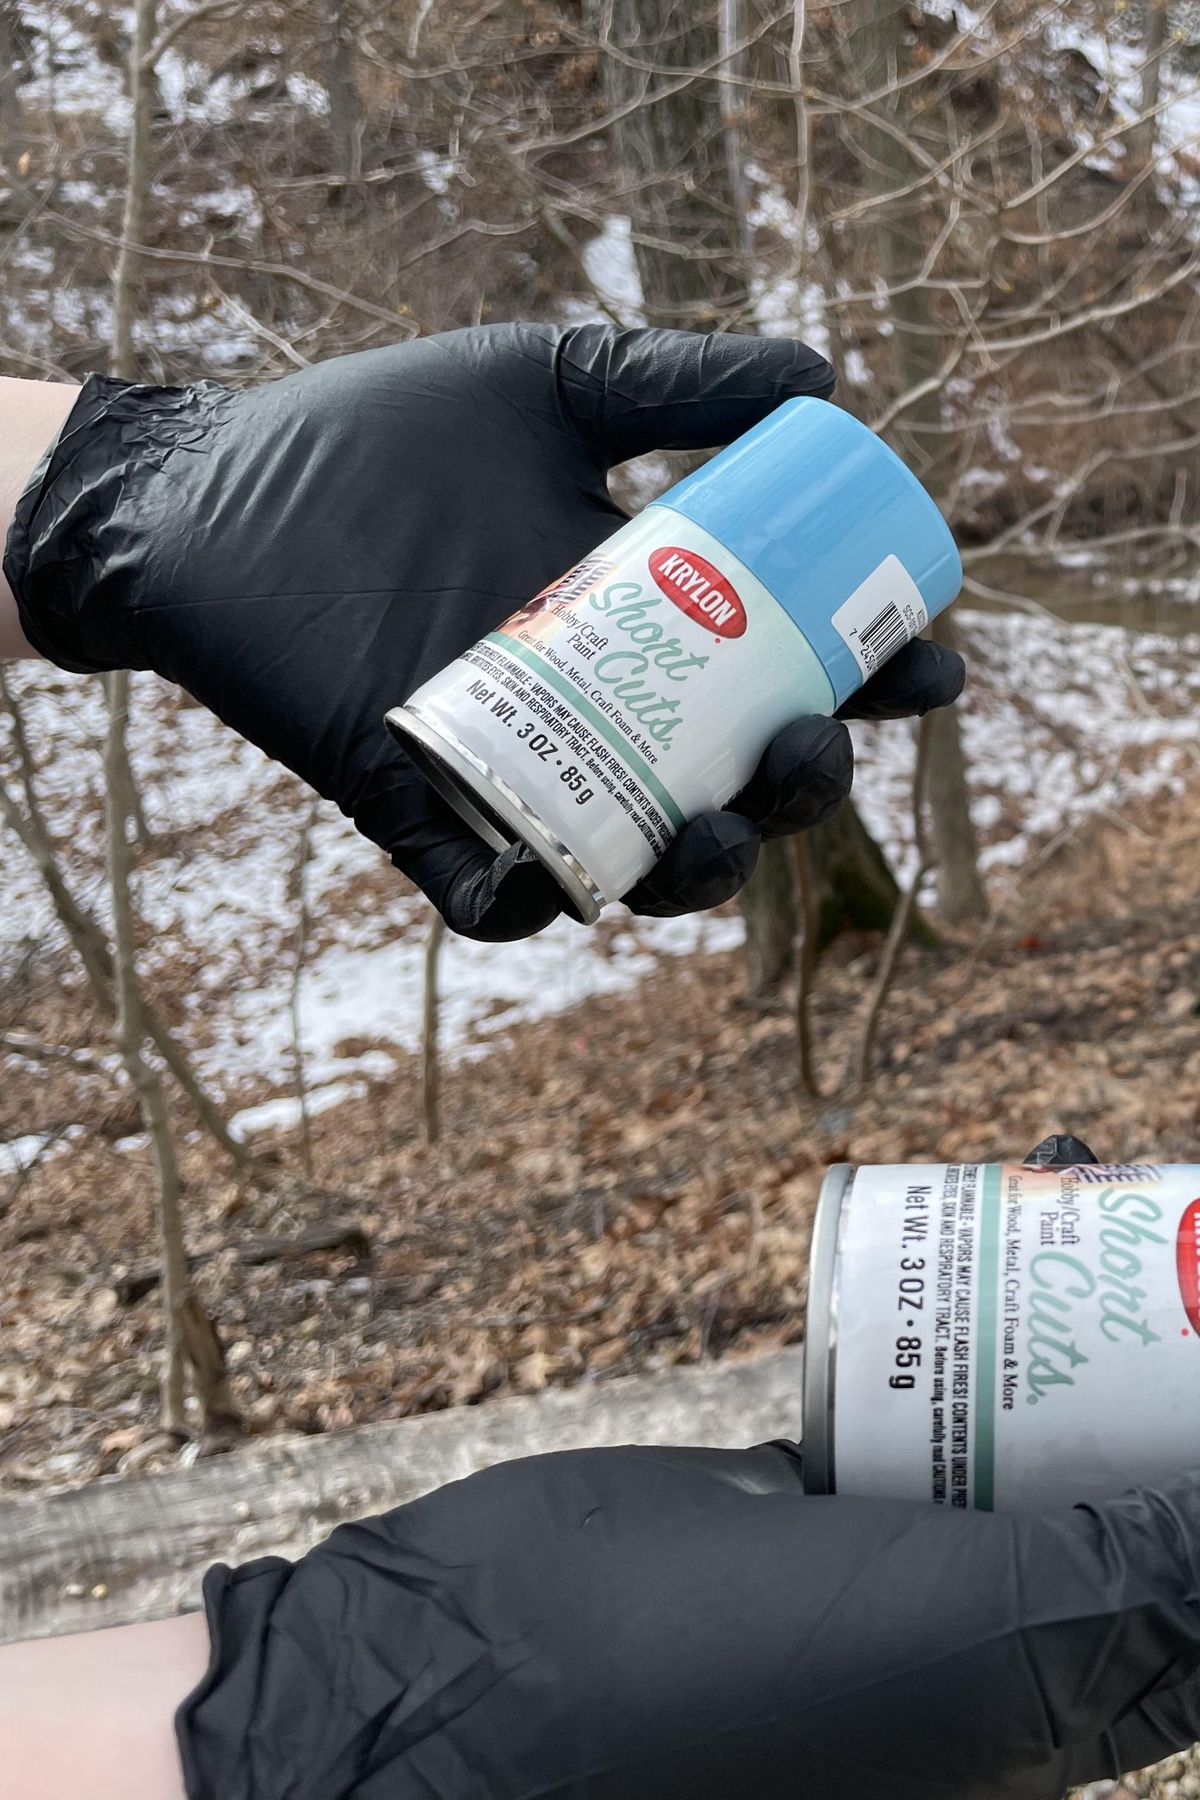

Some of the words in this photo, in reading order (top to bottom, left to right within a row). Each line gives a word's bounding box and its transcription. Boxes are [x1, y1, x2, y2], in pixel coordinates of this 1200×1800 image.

[657, 552, 737, 626] KRYLON
[550, 604, 607, 651] Hobby/Craft
[590, 585, 709, 680] Short
[565, 633, 594, 660] Paint
[518, 629, 536, 645] Great
[532, 640, 546, 652] for
[543, 647, 567, 671] Wood,
[565, 666, 592, 693] Metal,
[589, 690, 612, 713] Craft
[609, 710, 633, 735] Foam
[630, 733, 640, 745] &
[637, 740, 657, 764] More
[466, 679, 496, 704] Net
[490, 697, 517, 727] Wt.
[517, 723, 535, 739] 3
[529, 734, 558, 761] OZ
[560, 766, 587, 791] 85
[576, 787, 594, 805] g
[486, 665, 504, 682] EYES,
[500, 676, 519, 691] SKIN
[512, 686, 530, 702] AND
[525, 697, 570, 739] RESPIRATORY
[565, 735, 590, 761] TRACT.
[585, 757, 604, 778] Before
[600, 776, 615, 794] using,
[613, 791, 633, 814] carefully
[629, 810, 642, 823] read
[496, 656, 532, 684] FLAMMABLE
[530, 682, 558, 708] VAPORS
[555, 704, 572, 720] MAY
[566, 717, 592, 742] CAUSE
[586, 737, 611, 762] FLASH
[604, 757, 628, 781] FIRES!
[622, 777, 650, 811] CONTENTS
[644, 805, 663, 827] UNDER
[906, 1186, 932, 1210] Net
[1008, 1176, 1022, 1191] Great
[1008, 1193, 1022, 1204] for
[942, 1202, 956, 1216] SKIN
[1004, 1206, 1021, 1236] Wood,
[1060, 1177, 1079, 1246] Hobby/Craft
[902, 1216, 928, 1249] Wt.
[940, 1219, 954, 1235] AND
[1040, 1212, 1060, 1245] Paint
[958, 1227, 974, 1262] VAPORS
[1004, 1240, 1020, 1276] Metal,
[901, 1258, 925, 1271] 3
[937, 1239, 952, 1302] RESPIRATORY
[956, 1266, 970, 1286] MAY
[1098, 1188, 1168, 1346] Short
[898, 1279, 924, 1310] OZ
[955, 1290, 970, 1322] CAUSE
[1004, 1280, 1019, 1312] Craft
[935, 1307, 950, 1342] TRACT.
[1004, 1318, 1018, 1354] Foam
[896, 1337, 921, 1367] 85
[934, 1346, 947, 1374] Before
[954, 1327, 969, 1360] FLASH
[1004, 1359, 1017, 1369] &
[889, 1375, 915, 1388] g
[930, 1378, 946, 1404] using,
[952, 1365, 968, 1398] FIRES!
[1003, 1374, 1018, 1410] More
[931, 1408, 946, 1443] carefully
[952, 1402, 968, 1454] CONTENTS
[933, 1446, 945, 1462] read
[952, 1457, 967, 1486] UNDER
